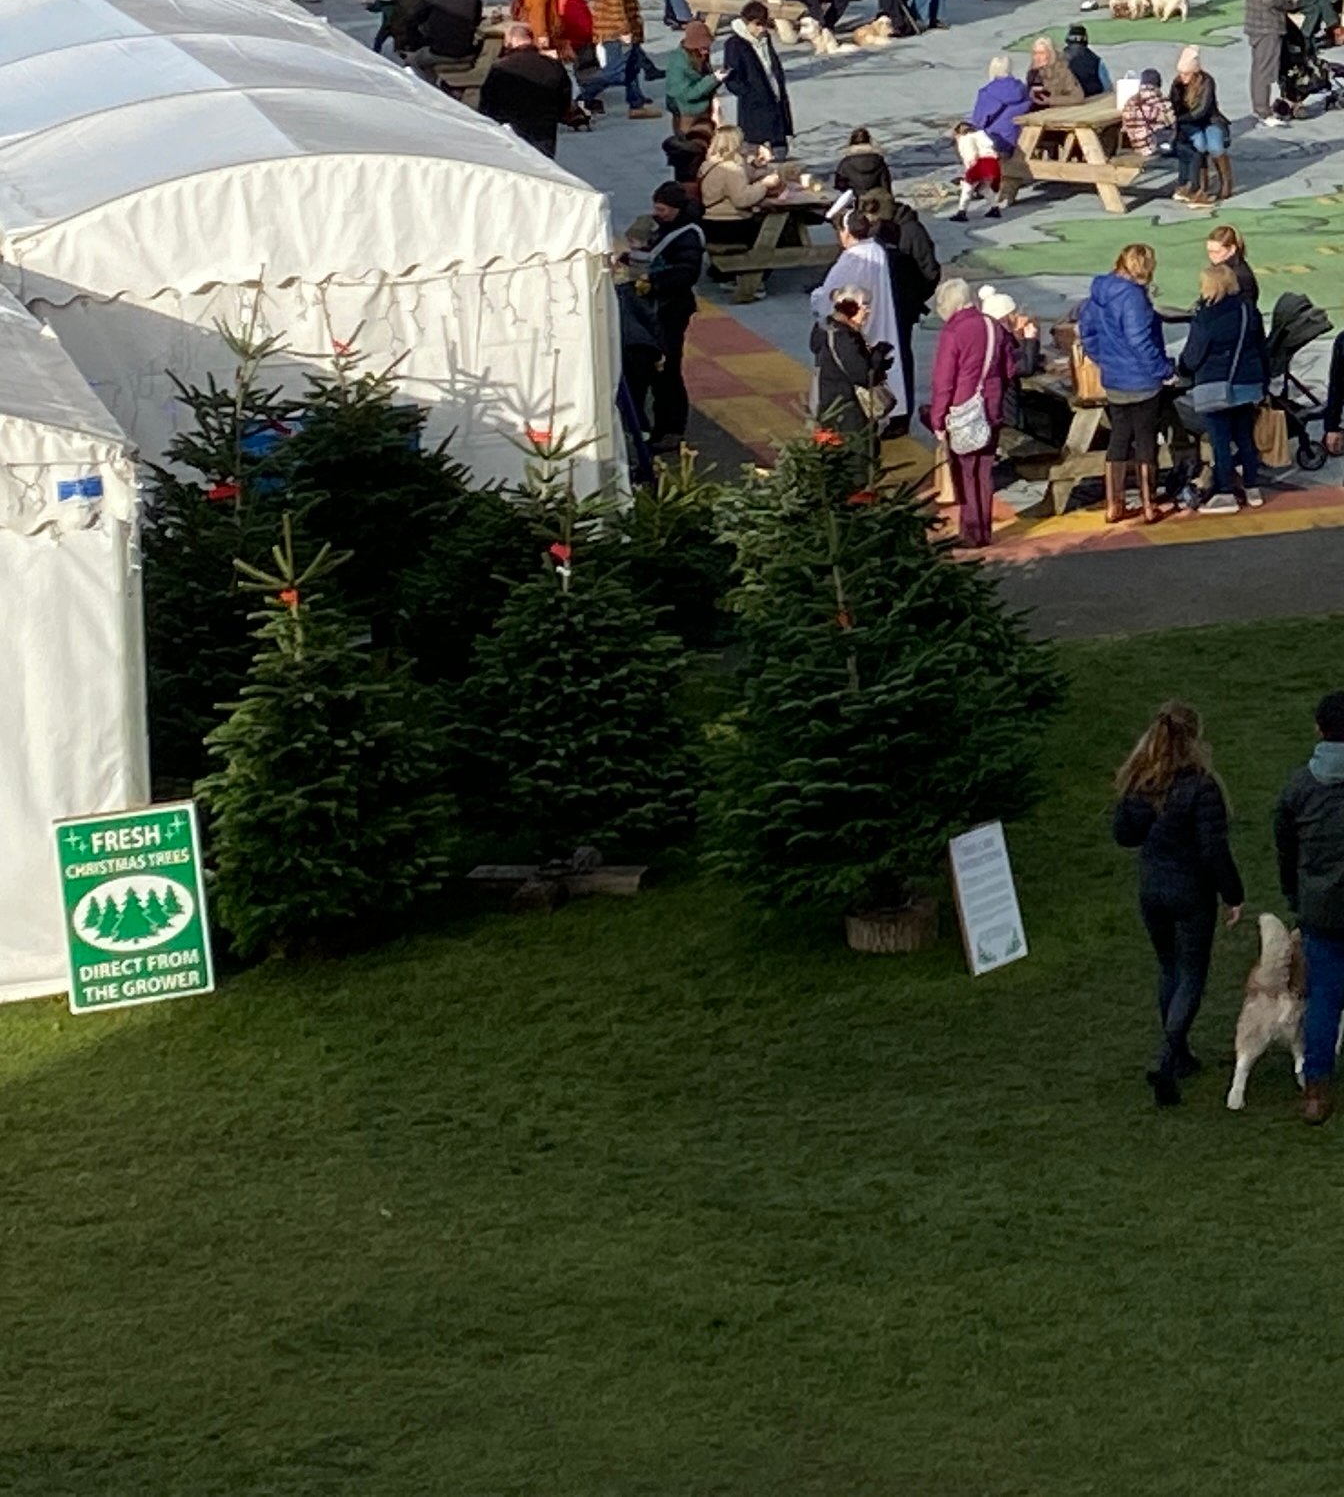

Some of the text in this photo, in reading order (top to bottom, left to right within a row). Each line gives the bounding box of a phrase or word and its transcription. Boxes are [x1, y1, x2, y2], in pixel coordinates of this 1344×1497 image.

[91, 824, 161, 854] FRESH
[65, 847, 190, 879] CHRISTMAS TREES
[80, 949, 200, 982] DIRECT FROM
[83, 970, 200, 1002] THE GROWER
